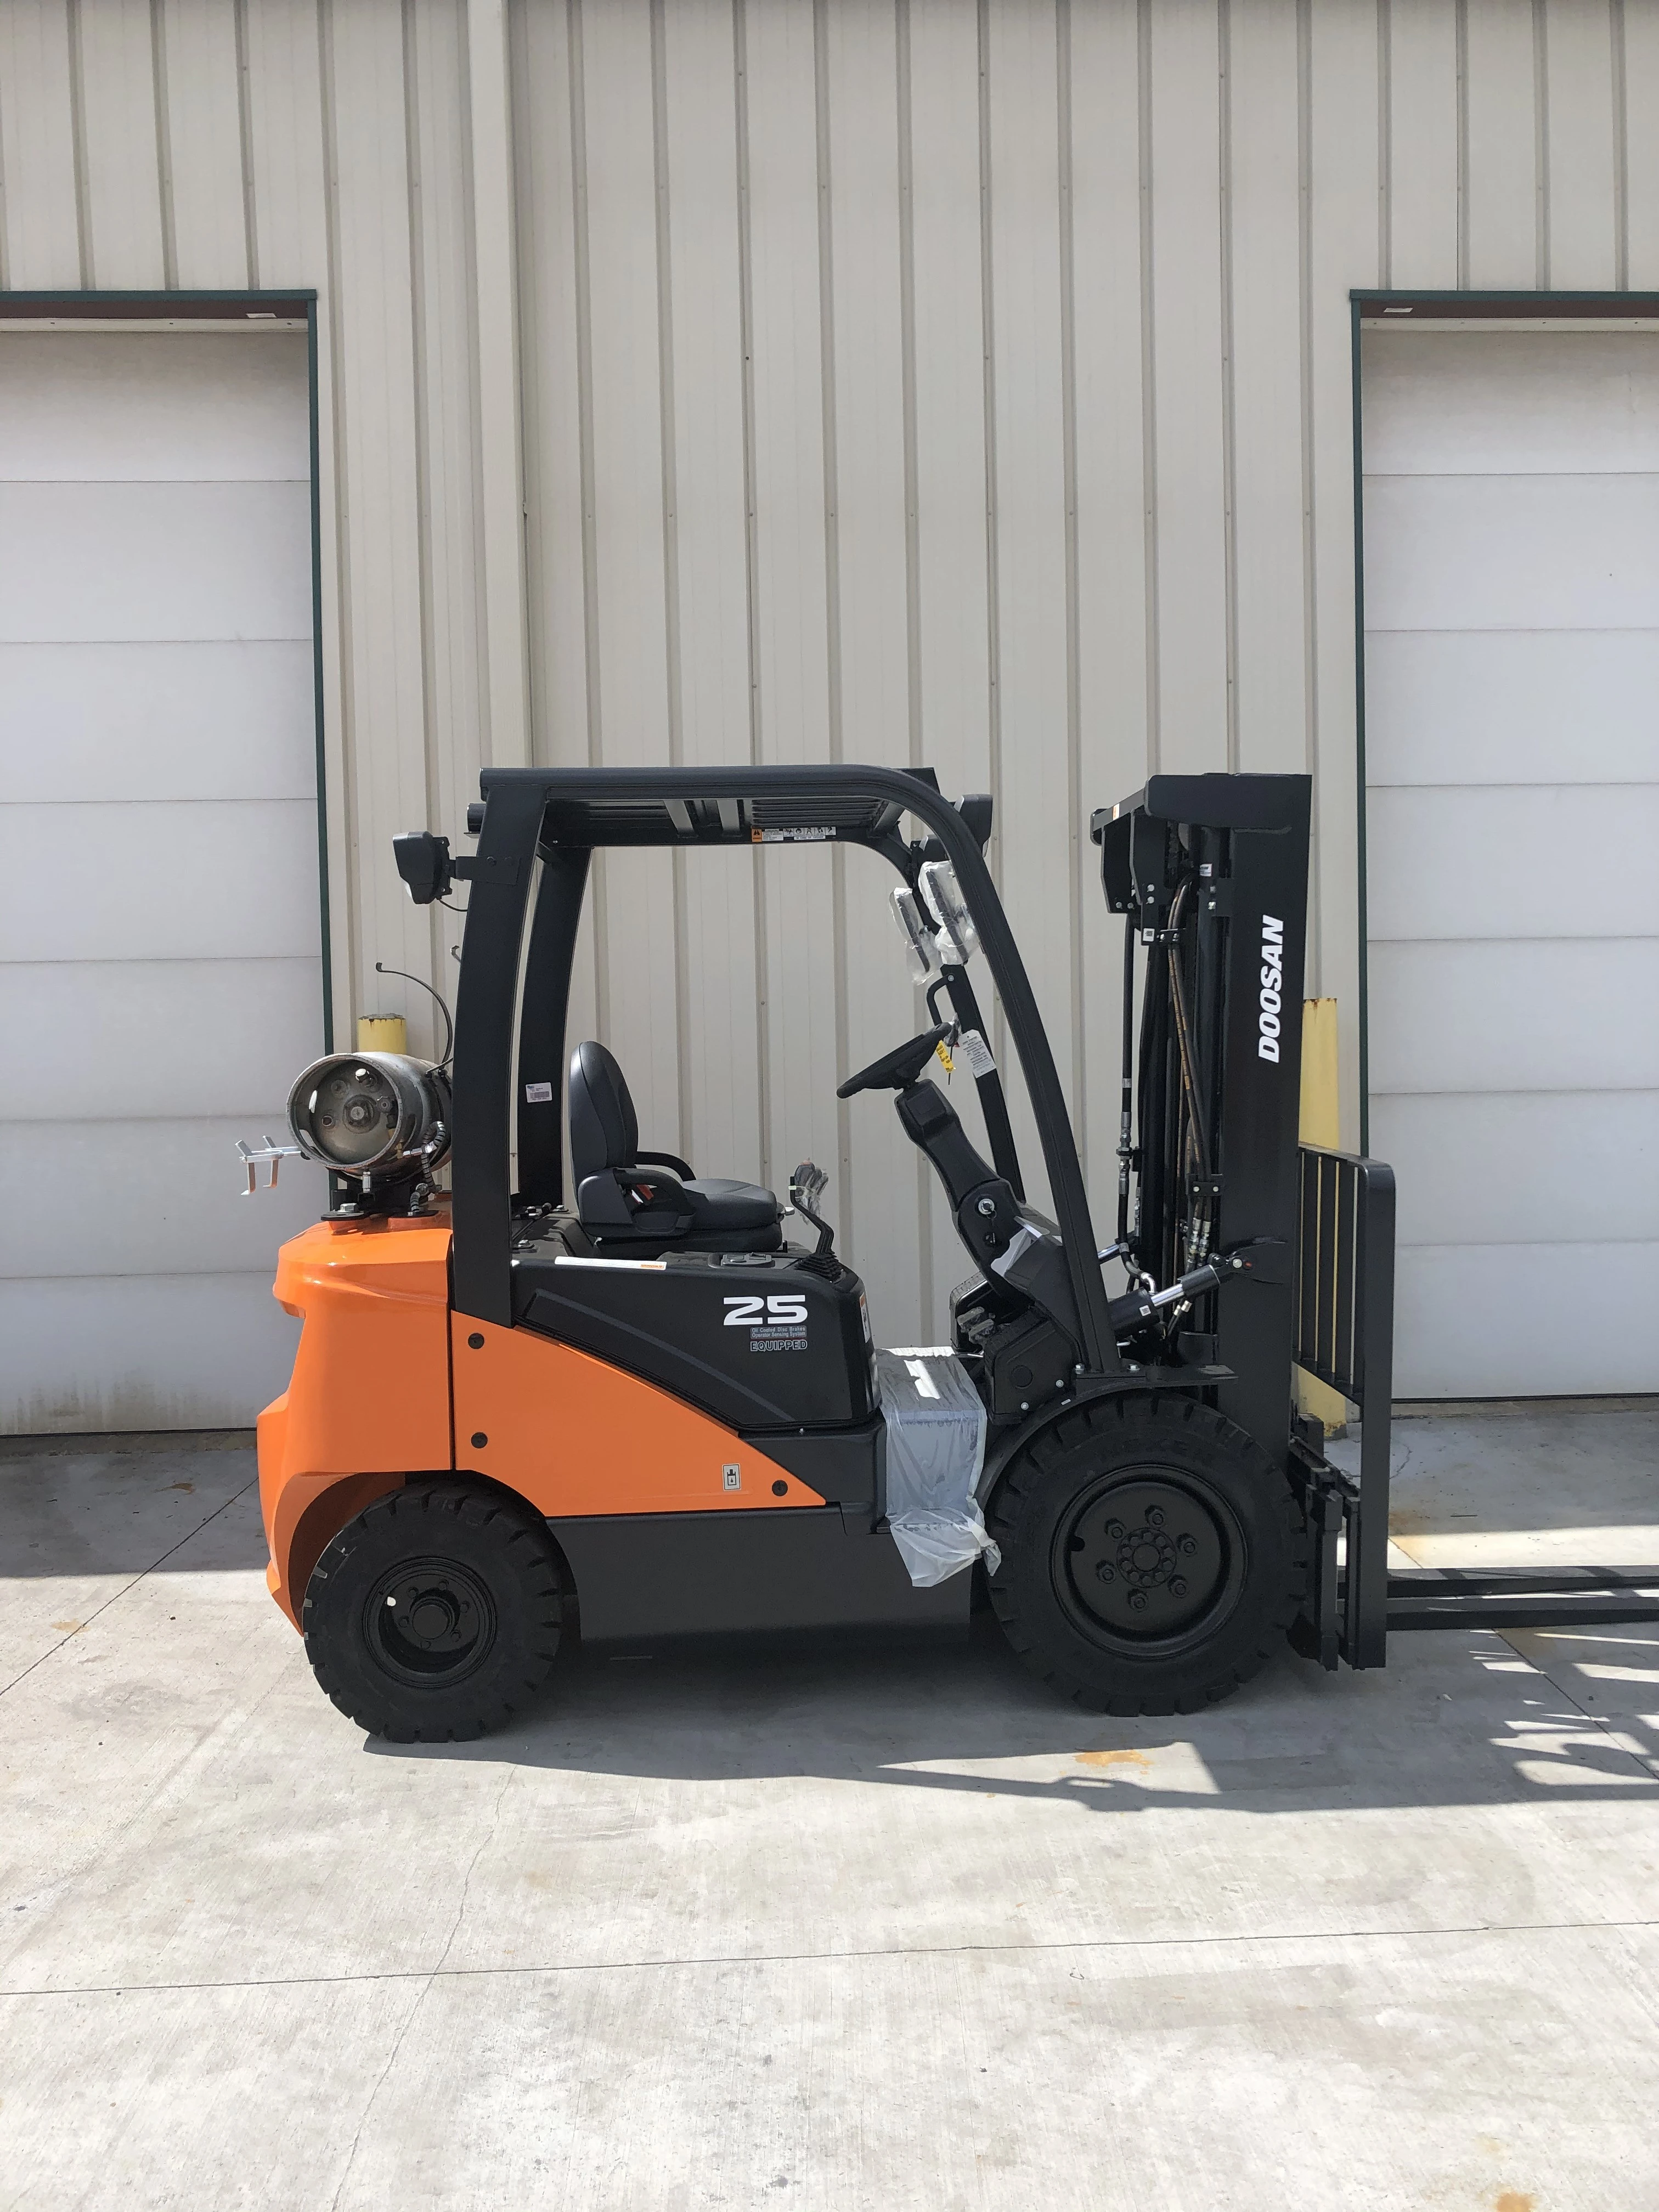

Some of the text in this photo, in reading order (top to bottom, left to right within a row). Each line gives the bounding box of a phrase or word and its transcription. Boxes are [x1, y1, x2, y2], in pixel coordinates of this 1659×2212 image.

[1259, 915, 1284, 1063] DOOSAN
[724, 1295, 808, 1325] 25
[750, 1339, 808, 1352] EQUIPPED
